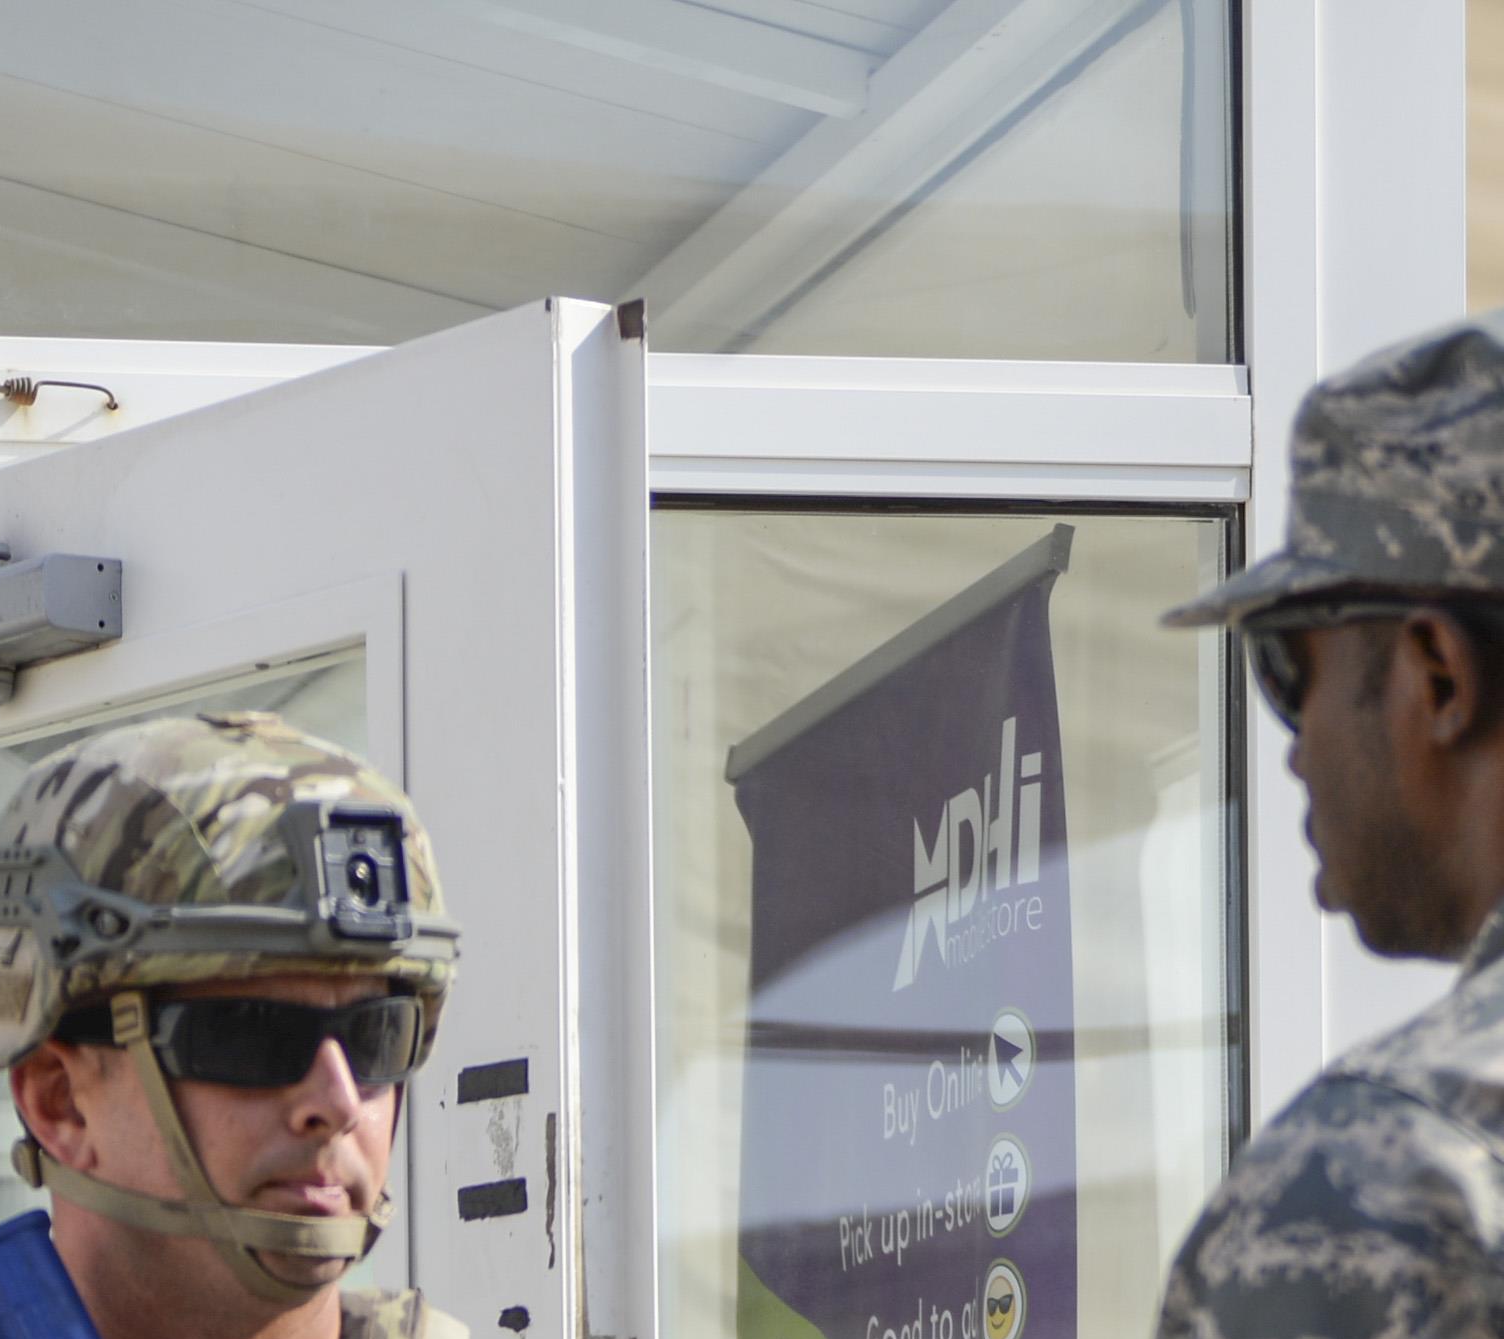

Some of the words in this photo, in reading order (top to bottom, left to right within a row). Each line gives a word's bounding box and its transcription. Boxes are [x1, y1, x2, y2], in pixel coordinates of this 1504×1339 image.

[883, 1083, 920, 1145] Buy
[840, 1203, 873, 1272] Pick
[881, 1206, 910, 1267] up
